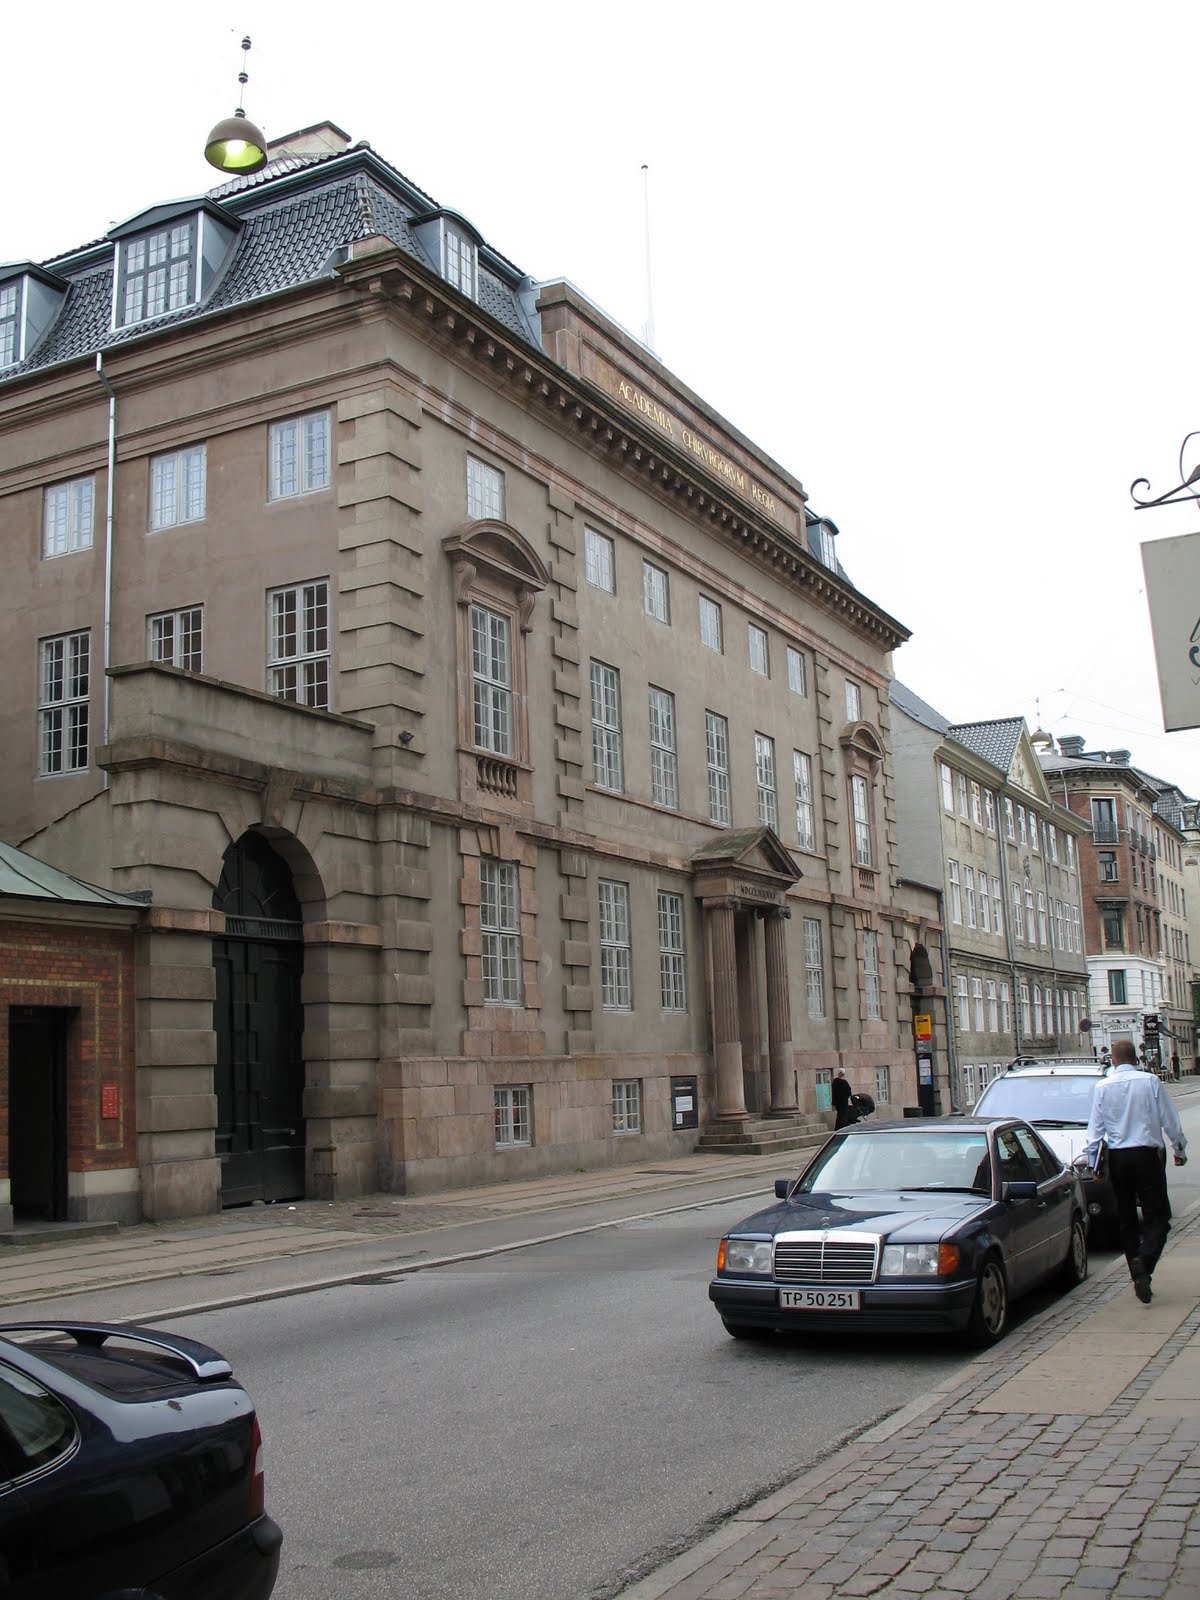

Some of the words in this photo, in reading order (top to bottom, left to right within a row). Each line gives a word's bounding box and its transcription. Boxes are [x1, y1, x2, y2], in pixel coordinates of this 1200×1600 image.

[618, 381, 673, 434] ACADEMIA
[682, 430, 745, 490] CHIRVRGORVM
[751, 484, 776, 515] REGIA
[783, 1292, 802, 1305] TP
[807, 1293, 825, 1306] 50
[828, 1293, 853, 1307] 251
